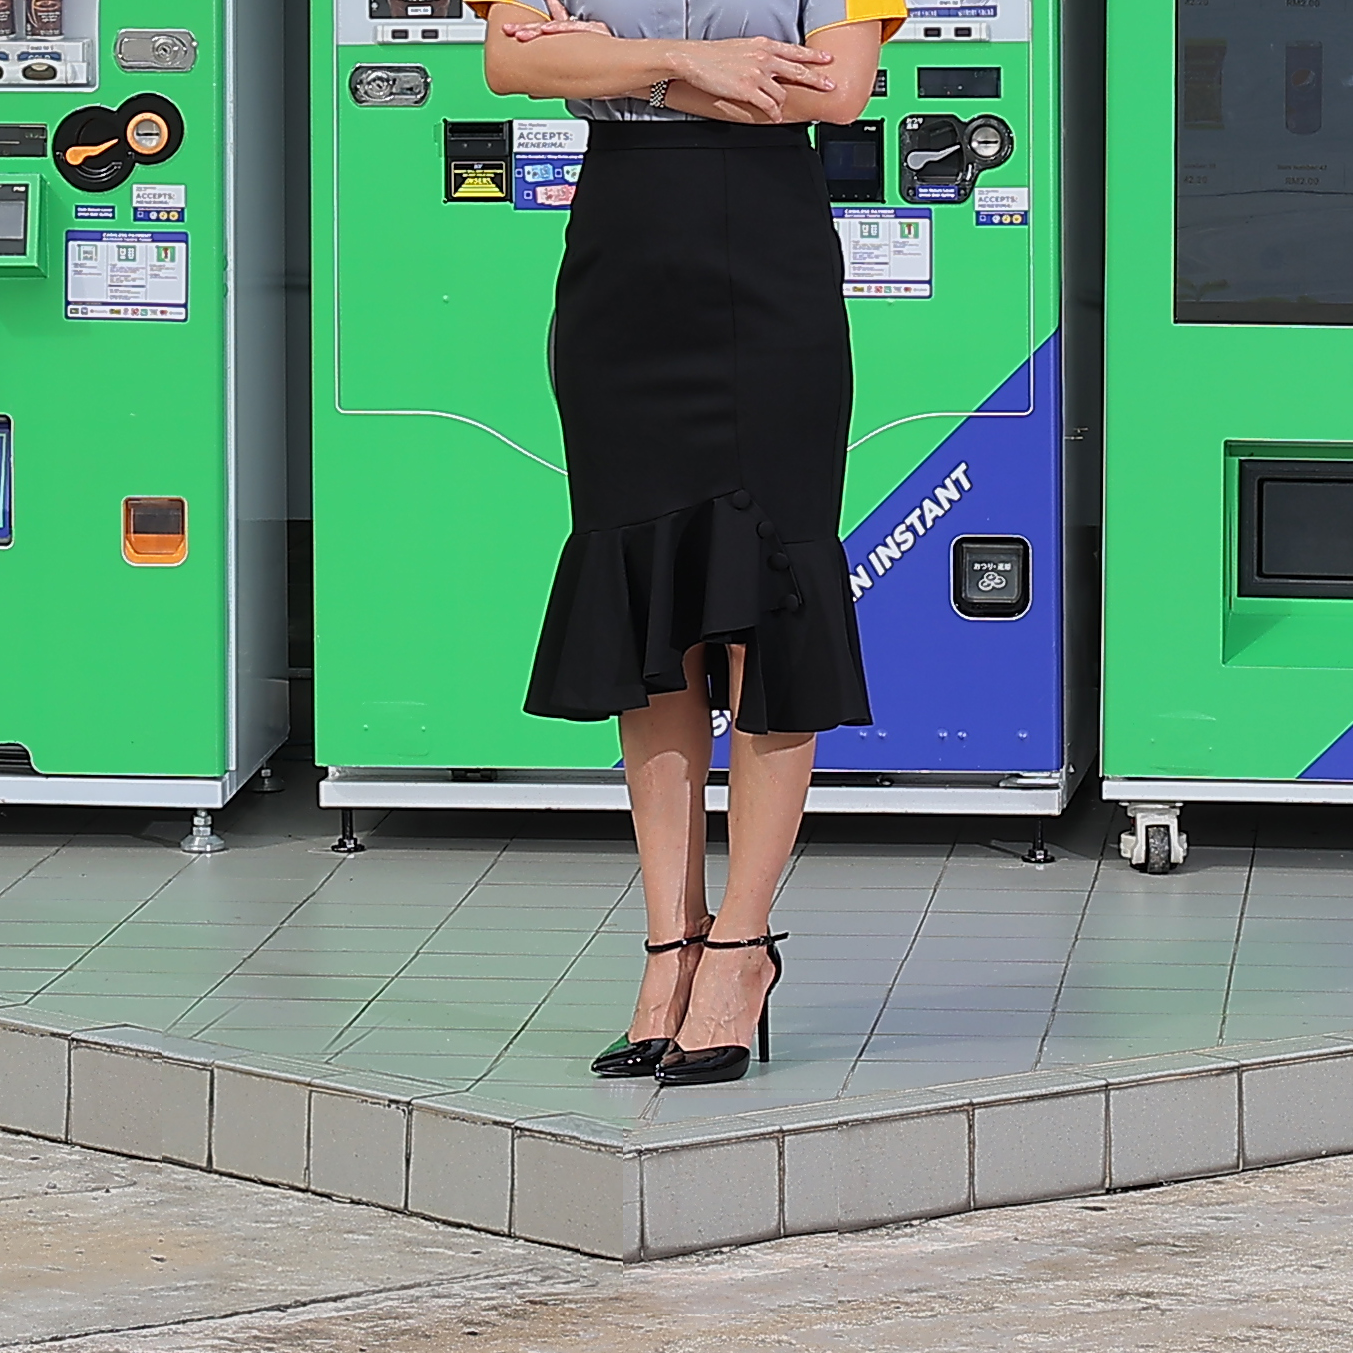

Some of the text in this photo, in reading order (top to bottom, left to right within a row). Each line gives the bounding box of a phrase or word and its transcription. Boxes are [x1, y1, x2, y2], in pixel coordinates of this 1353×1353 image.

[1286, 0, 1321, 8] RM2.00
[517, 131, 573, 142] ACCEPTS:
[867, 460, 973, 577] INSTANT
